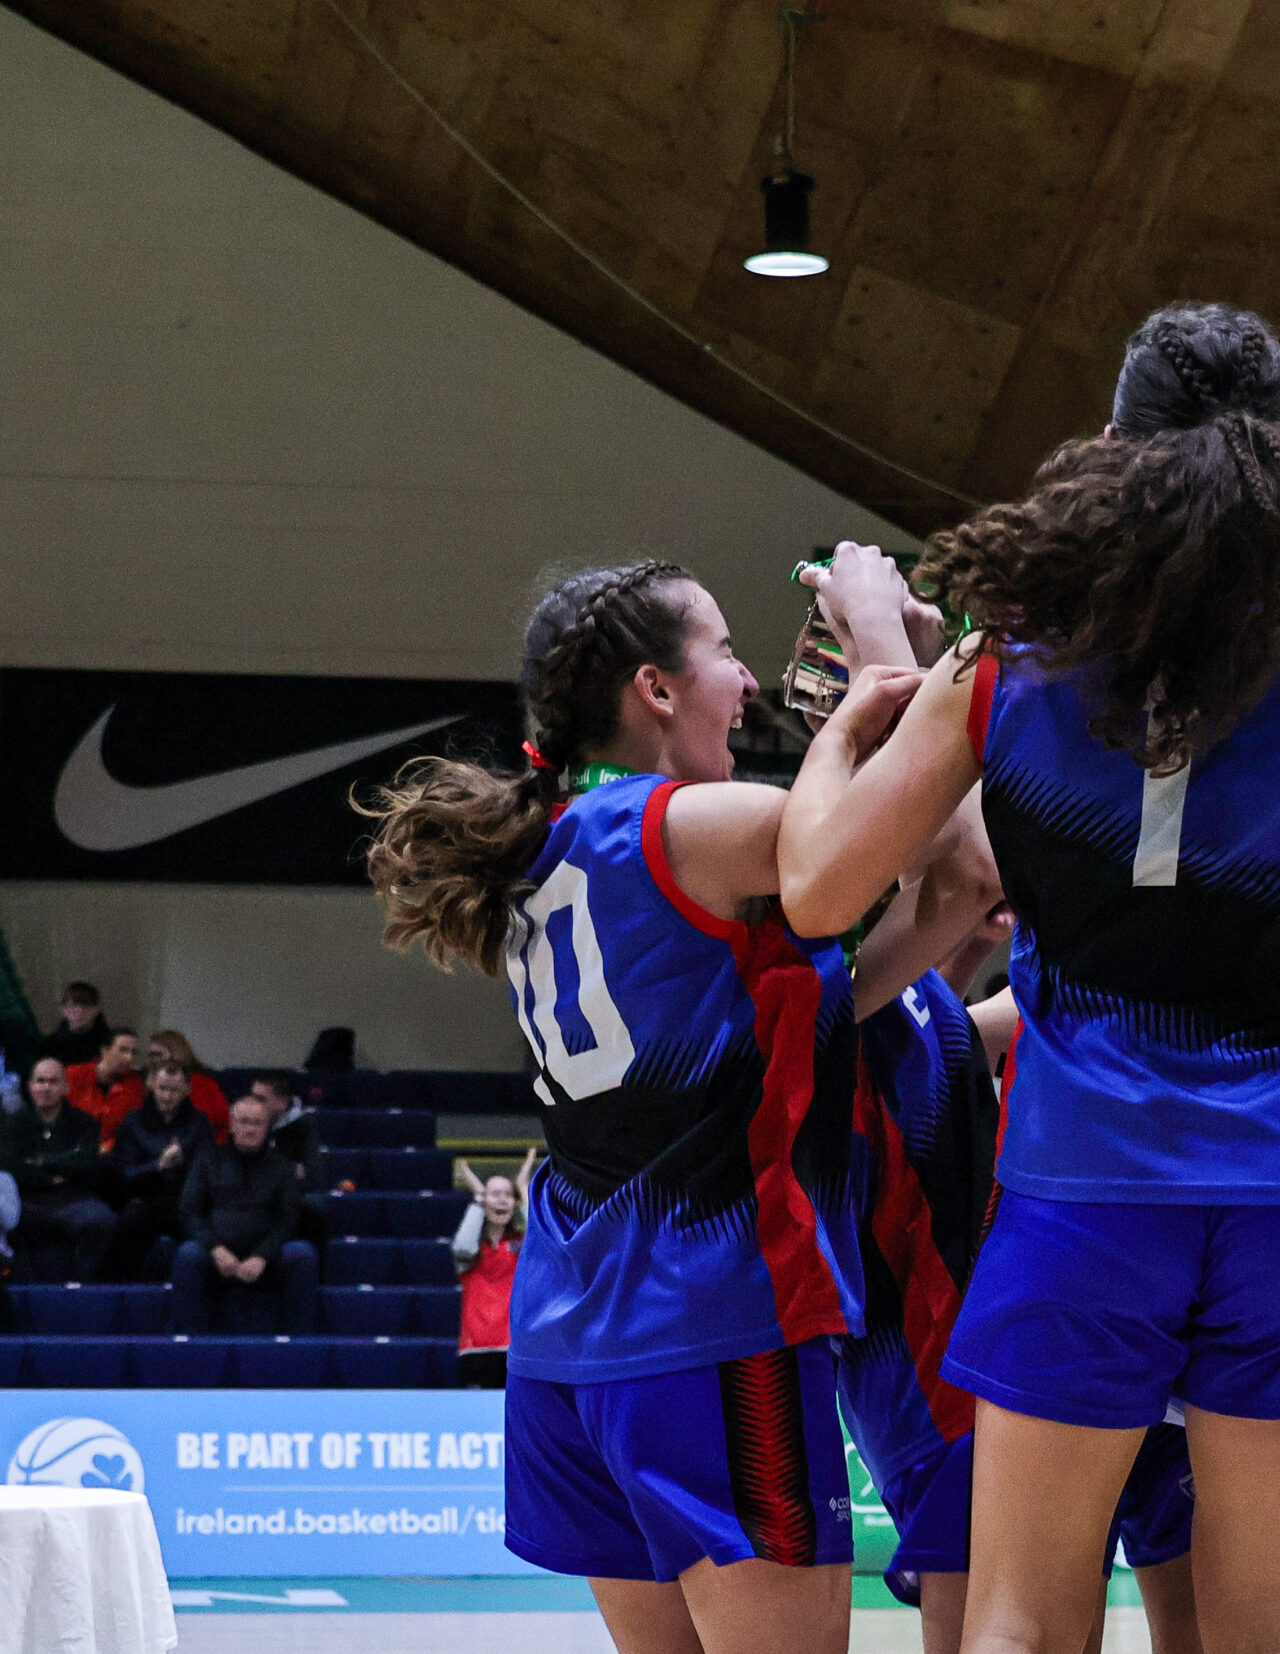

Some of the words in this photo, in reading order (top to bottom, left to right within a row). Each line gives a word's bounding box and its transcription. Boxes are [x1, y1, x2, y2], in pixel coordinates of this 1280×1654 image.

[177, 1432, 220, 1469] BE
[227, 1432, 314, 1469] PART
[320, 1432, 362, 1470] OF
[368, 1431, 431, 1469] THE
[436, 1431, 505, 1470] ACT
